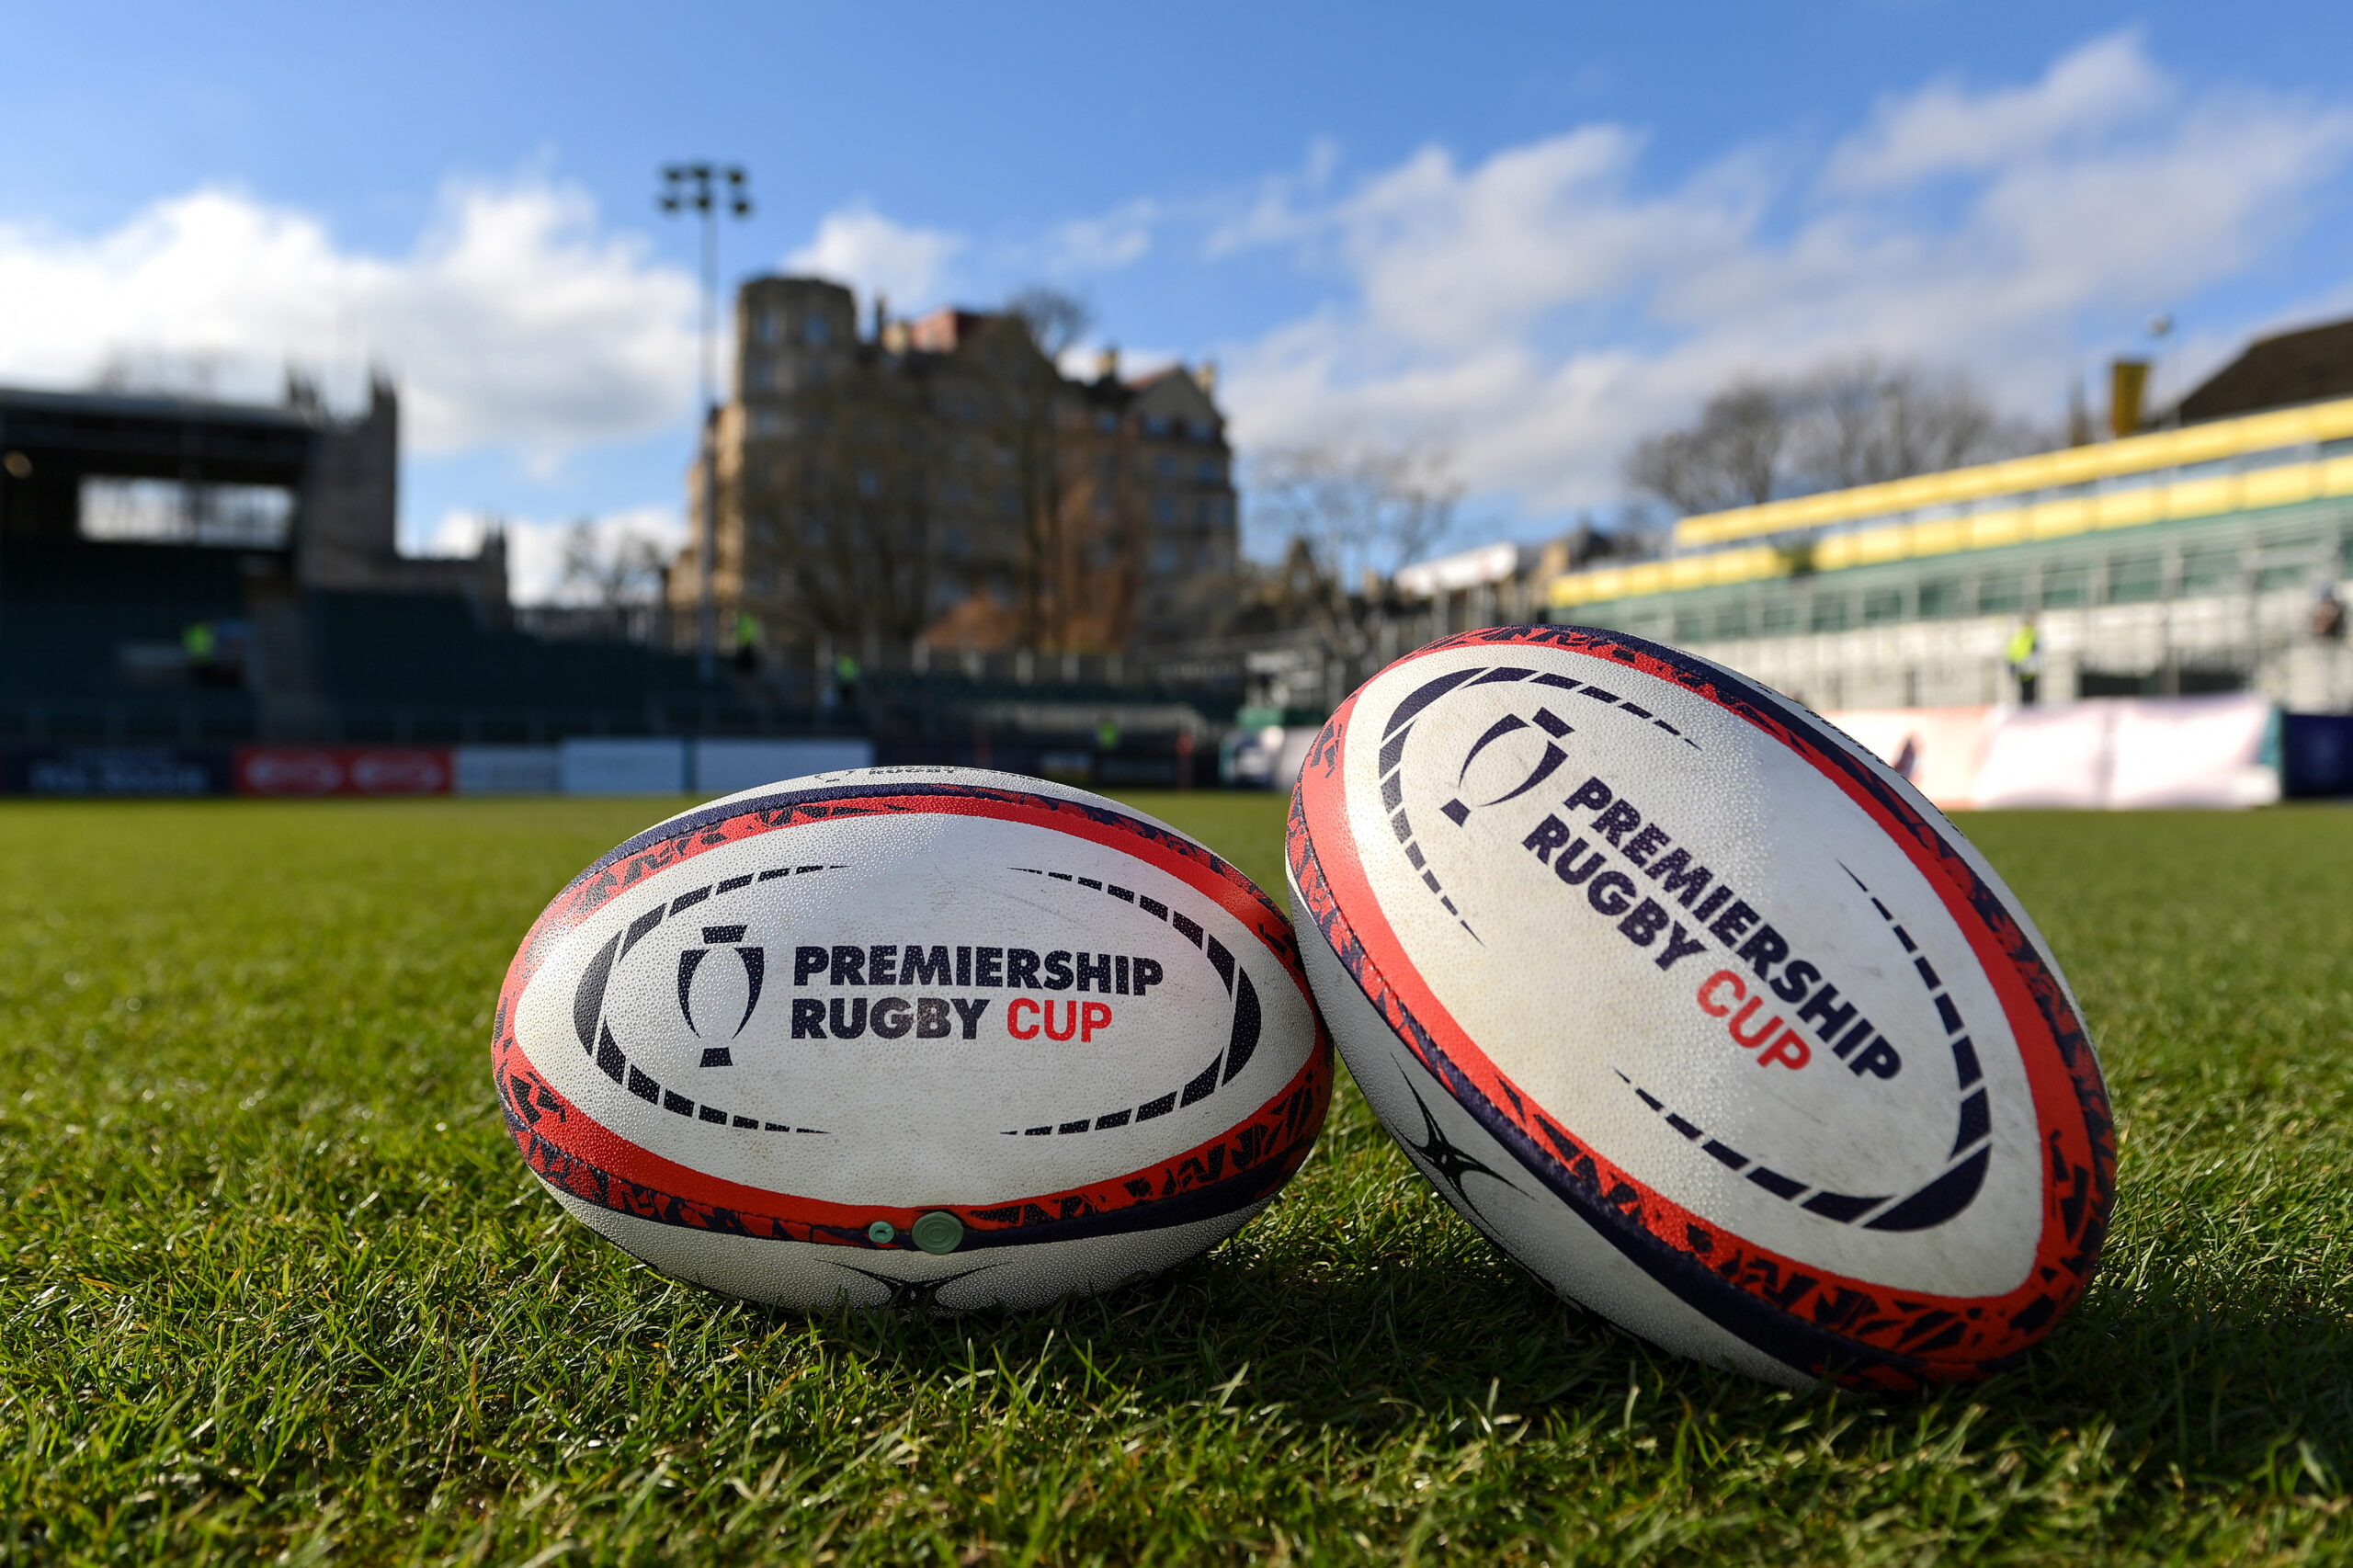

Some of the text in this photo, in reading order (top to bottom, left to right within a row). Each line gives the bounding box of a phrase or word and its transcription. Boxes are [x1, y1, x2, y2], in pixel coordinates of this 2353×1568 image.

[794, 945, 1164, 996] PREMIERSHIP
[1522, 814, 1811, 1070] RUGBY CUP
[1563, 777, 1901, 1079] PREMIERSHIP
[791, 997, 1112, 1042] RUGBY CUP
